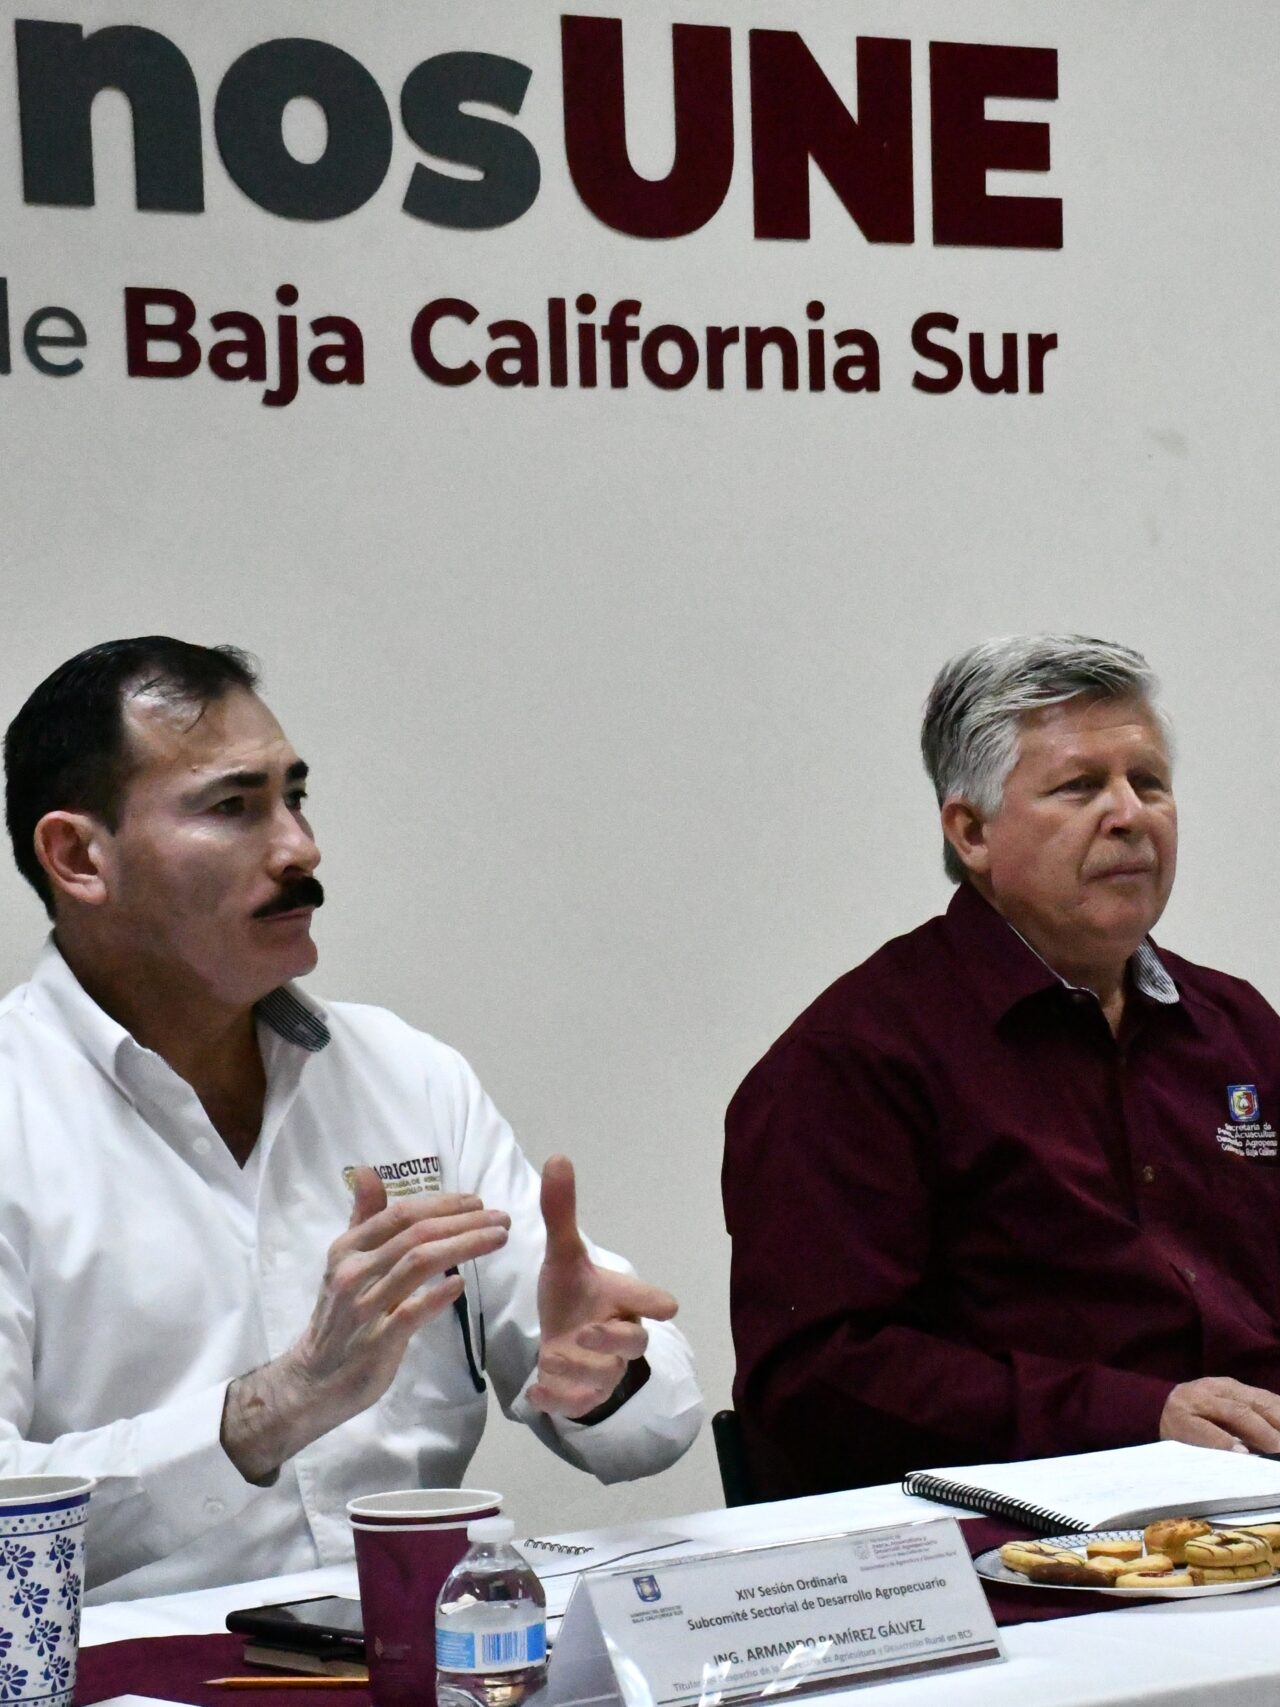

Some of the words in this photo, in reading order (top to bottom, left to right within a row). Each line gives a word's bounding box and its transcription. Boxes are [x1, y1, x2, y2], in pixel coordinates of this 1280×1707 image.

[124, 283, 365, 408] Baja
[410, 293, 882, 395] California
[911, 311, 1057, 396] Sur
[687, 1610, 748, 1631] Subcomité
[750, 1599, 800, 1620] Sectorial
[801, 1598, 815, 1611] de
[816, 1589, 873, 1608] Desarrollo
[875, 1576, 947, 1601] Agropecuario
[735, 1587, 755, 1601] XIV
[757, 1581, 795, 1599] Sesión
[796, 1573, 848, 1591] Ordinaria
[878, 1618, 925, 1638] GÁLVEZ
